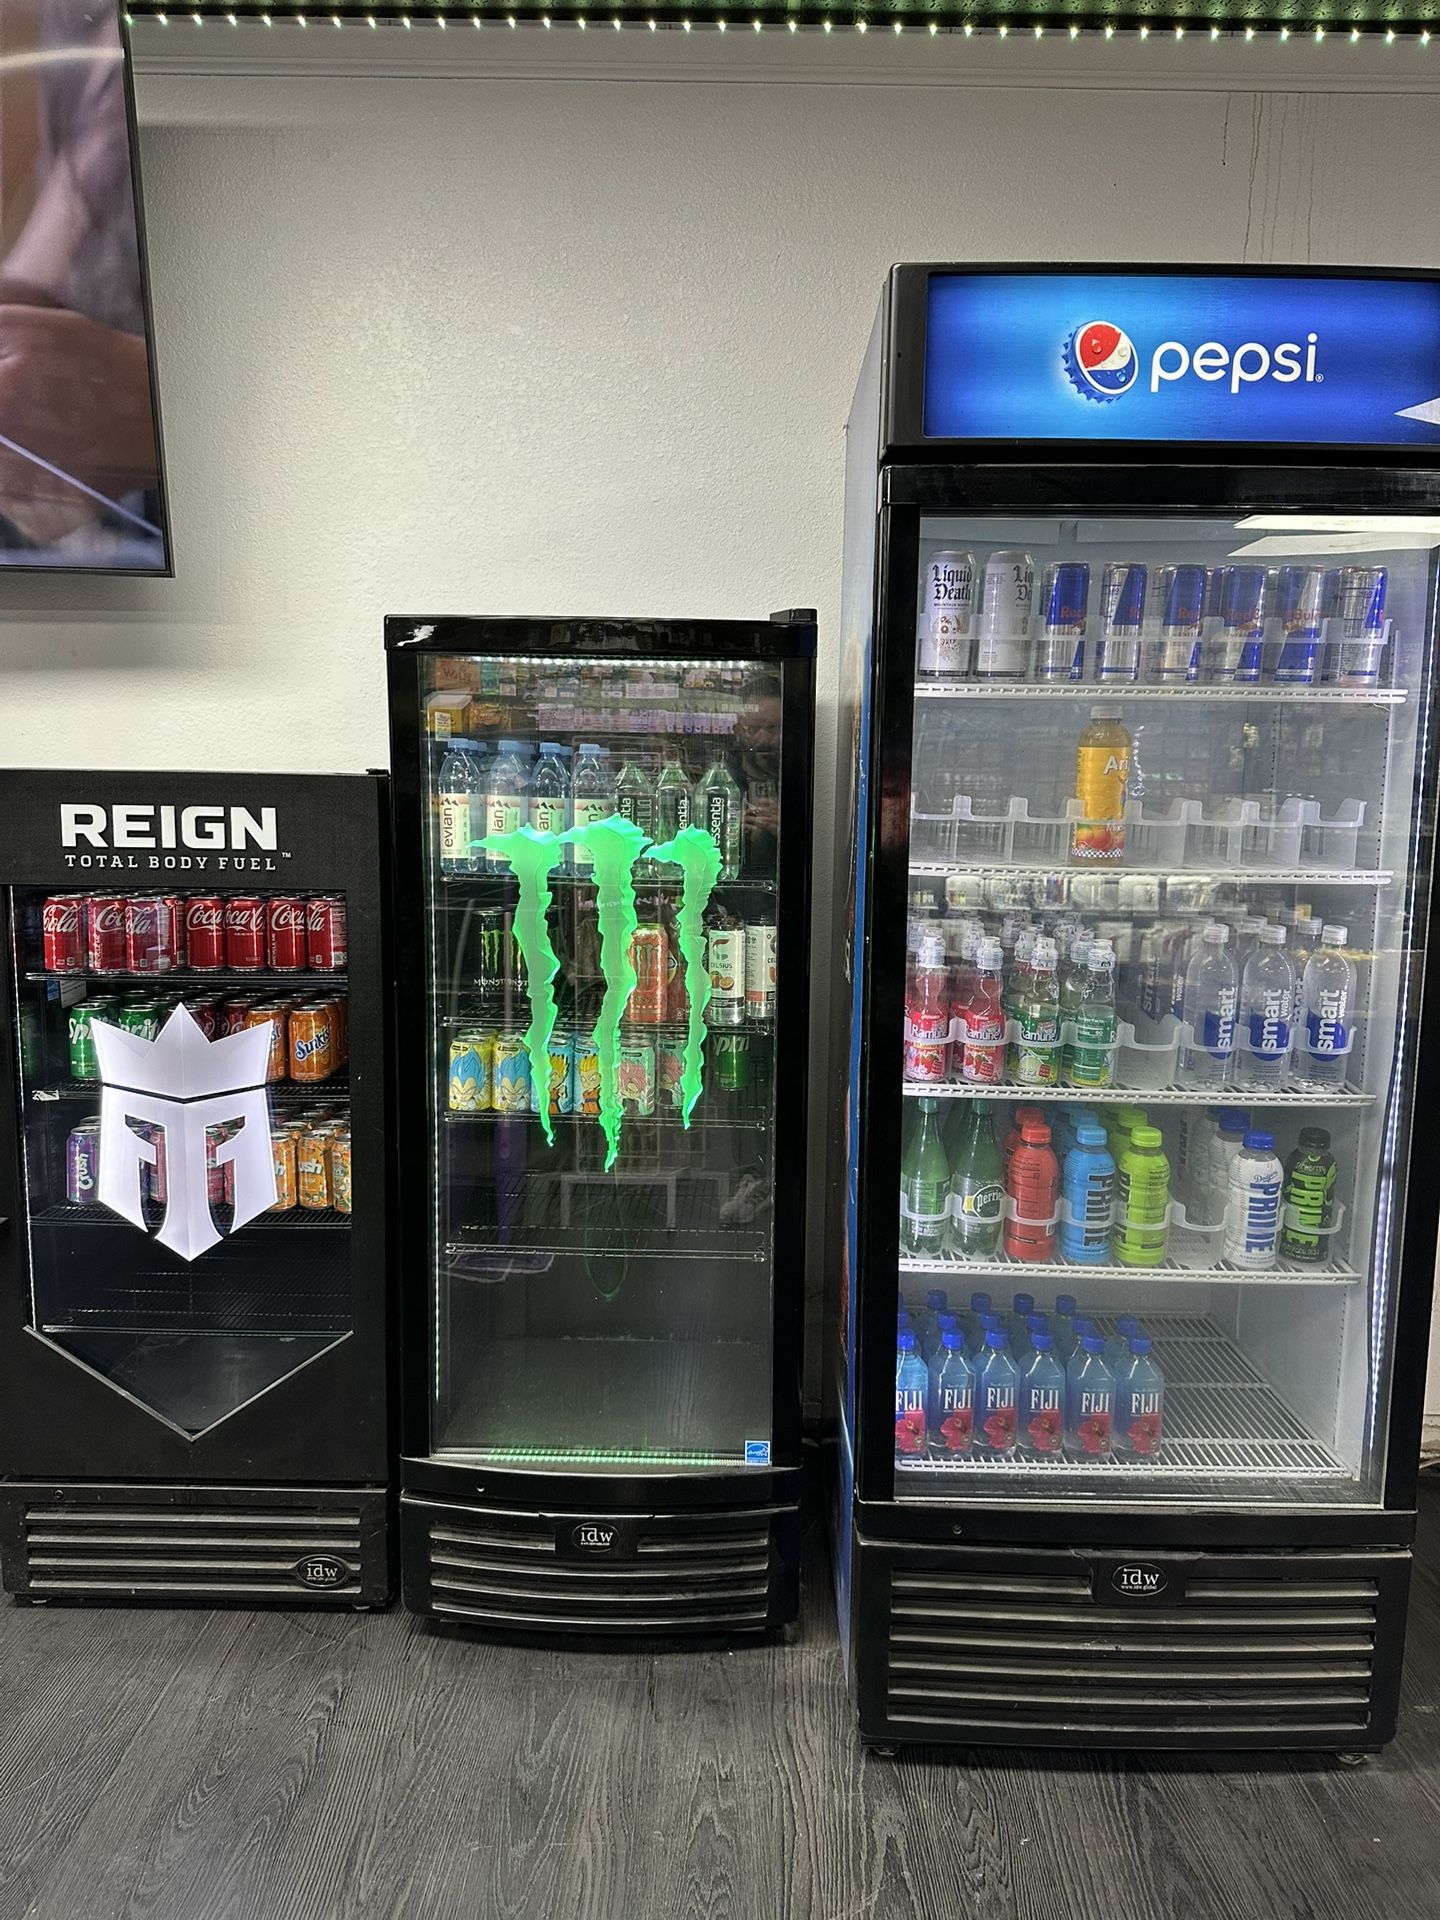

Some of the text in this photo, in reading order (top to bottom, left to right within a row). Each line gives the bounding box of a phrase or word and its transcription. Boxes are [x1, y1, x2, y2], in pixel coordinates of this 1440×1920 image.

[1151, 332, 1318, 393] pepsi
[932, 564, 972, 587] Liquid
[933, 583, 971, 600] Death
[492, 809, 504, 832] ian
[677, 799, 688, 830] entia
[60, 803, 279, 851] REIGN
[442, 807, 454, 848] evian
[65, 854, 276, 871] TOTAL BODY FUEL
[710, 961, 733, 969] CELSIUS
[1338, 990, 1348, 1019] water
[1218, 987, 1235, 1050] smart
[1262, 989, 1282, 1052] smart
[1317, 989, 1340, 1052] smart
[1245, 1181, 1281, 1253] PRIME
[1286, 1171, 1327, 1248] PRIME
[895, 1390, 922, 1412] FIJI
[944, 1388, 972, 1409] FIJI
[987, 1387, 1014, 1408] FIJI
[1030, 1388, 1059, 1410] FIJI
[1081, 1392, 1109, 1413] FIJI
[1131, 1393, 1159, 1414] FIJI
[580, 1527, 613, 1542] idw
[307, 1563, 338, 1577] idw
[1121, 1568, 1159, 1585] idw
